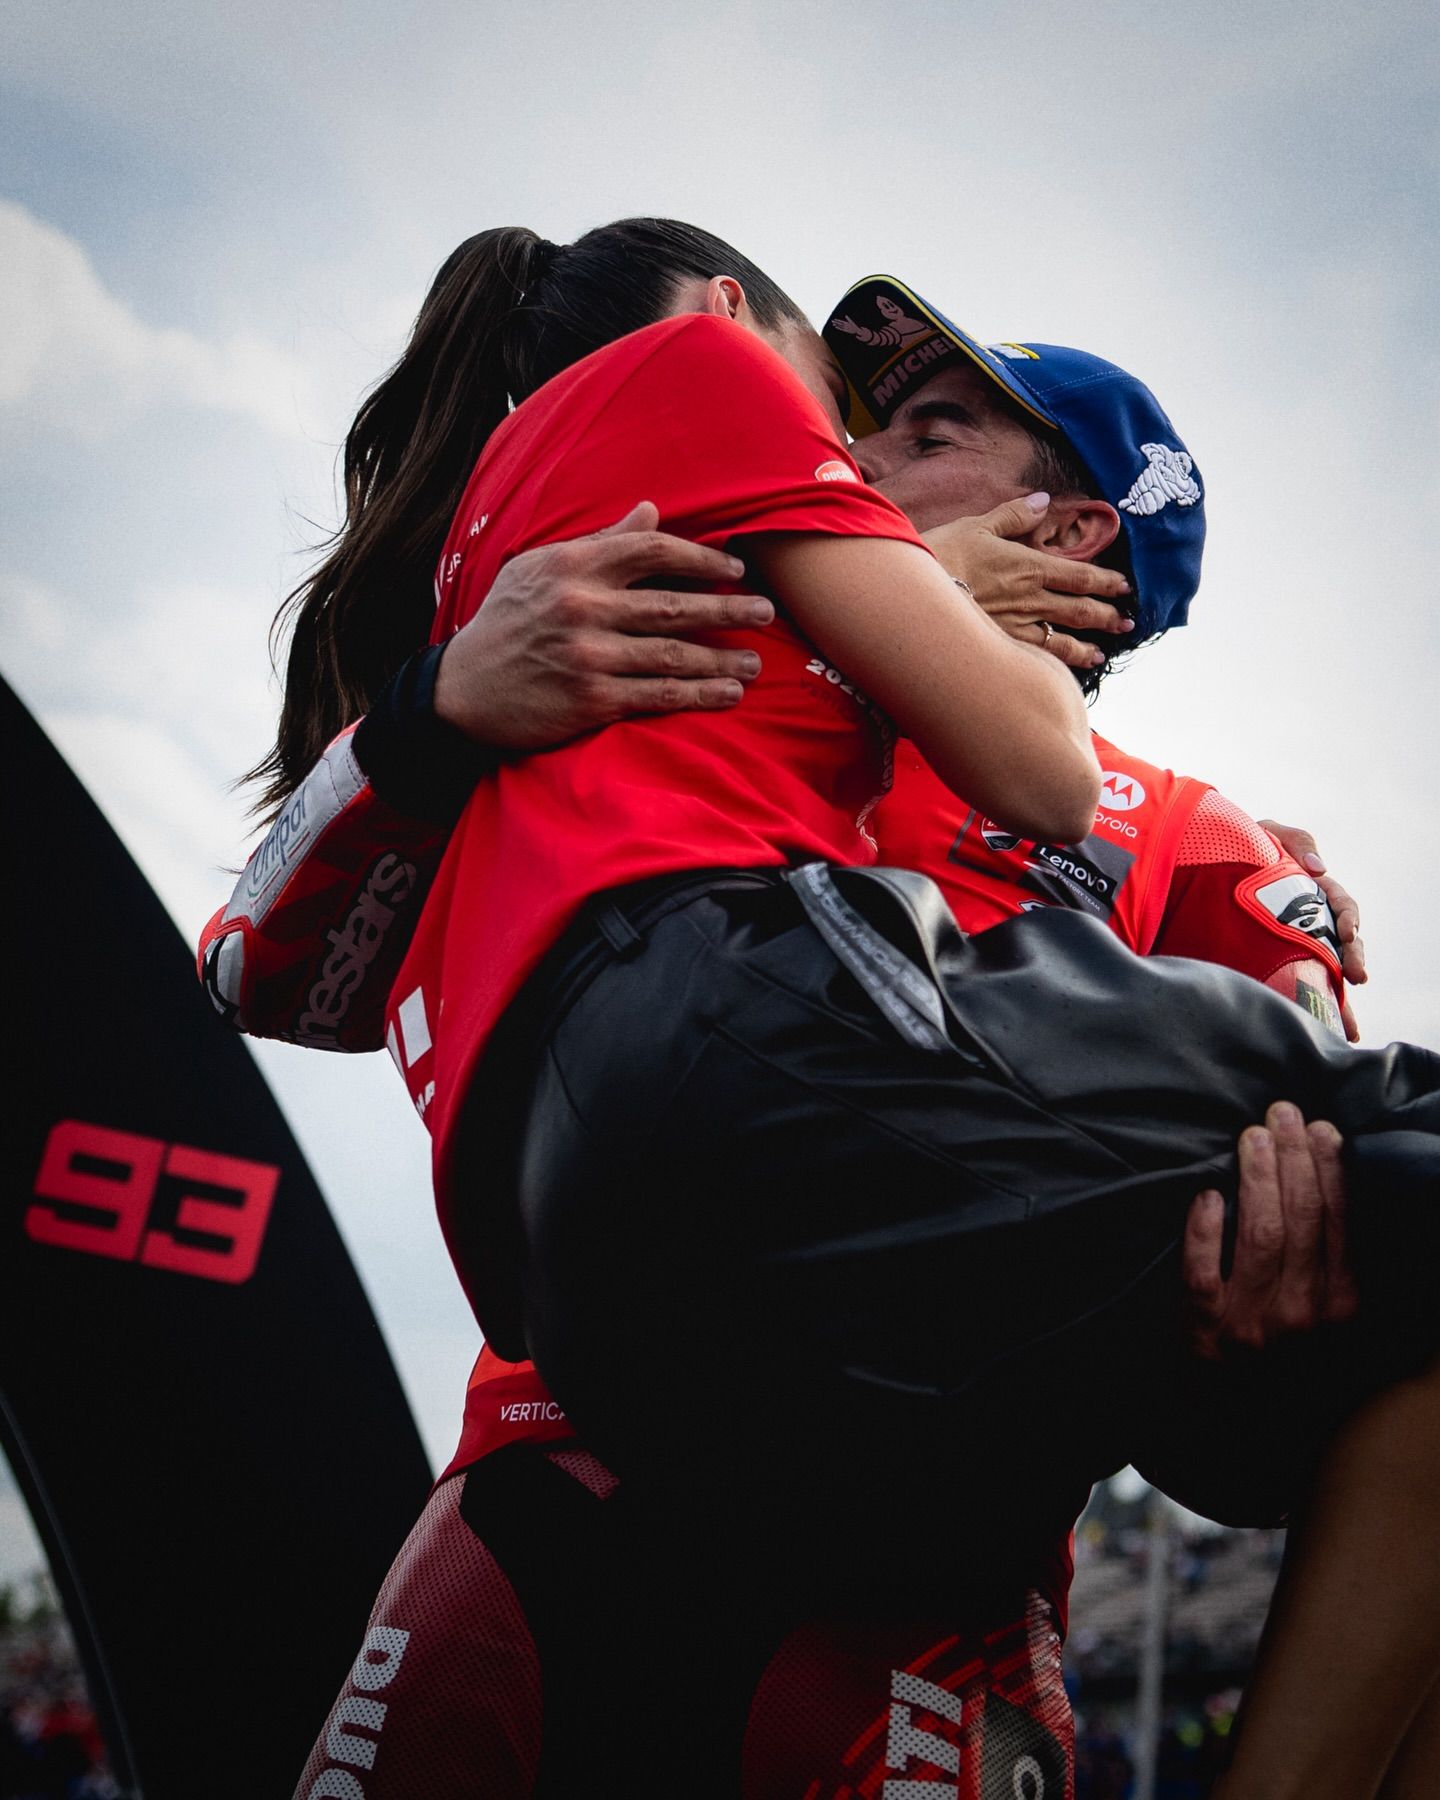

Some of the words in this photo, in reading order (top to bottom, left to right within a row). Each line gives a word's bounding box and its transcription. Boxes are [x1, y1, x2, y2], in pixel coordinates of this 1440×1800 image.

[1039, 847, 1108, 893] Lenovo
[1059, 874, 1085, 897] FACTORY
[1084, 894, 1101, 911] TEAM
[24, 1118, 281, 1286] 93
